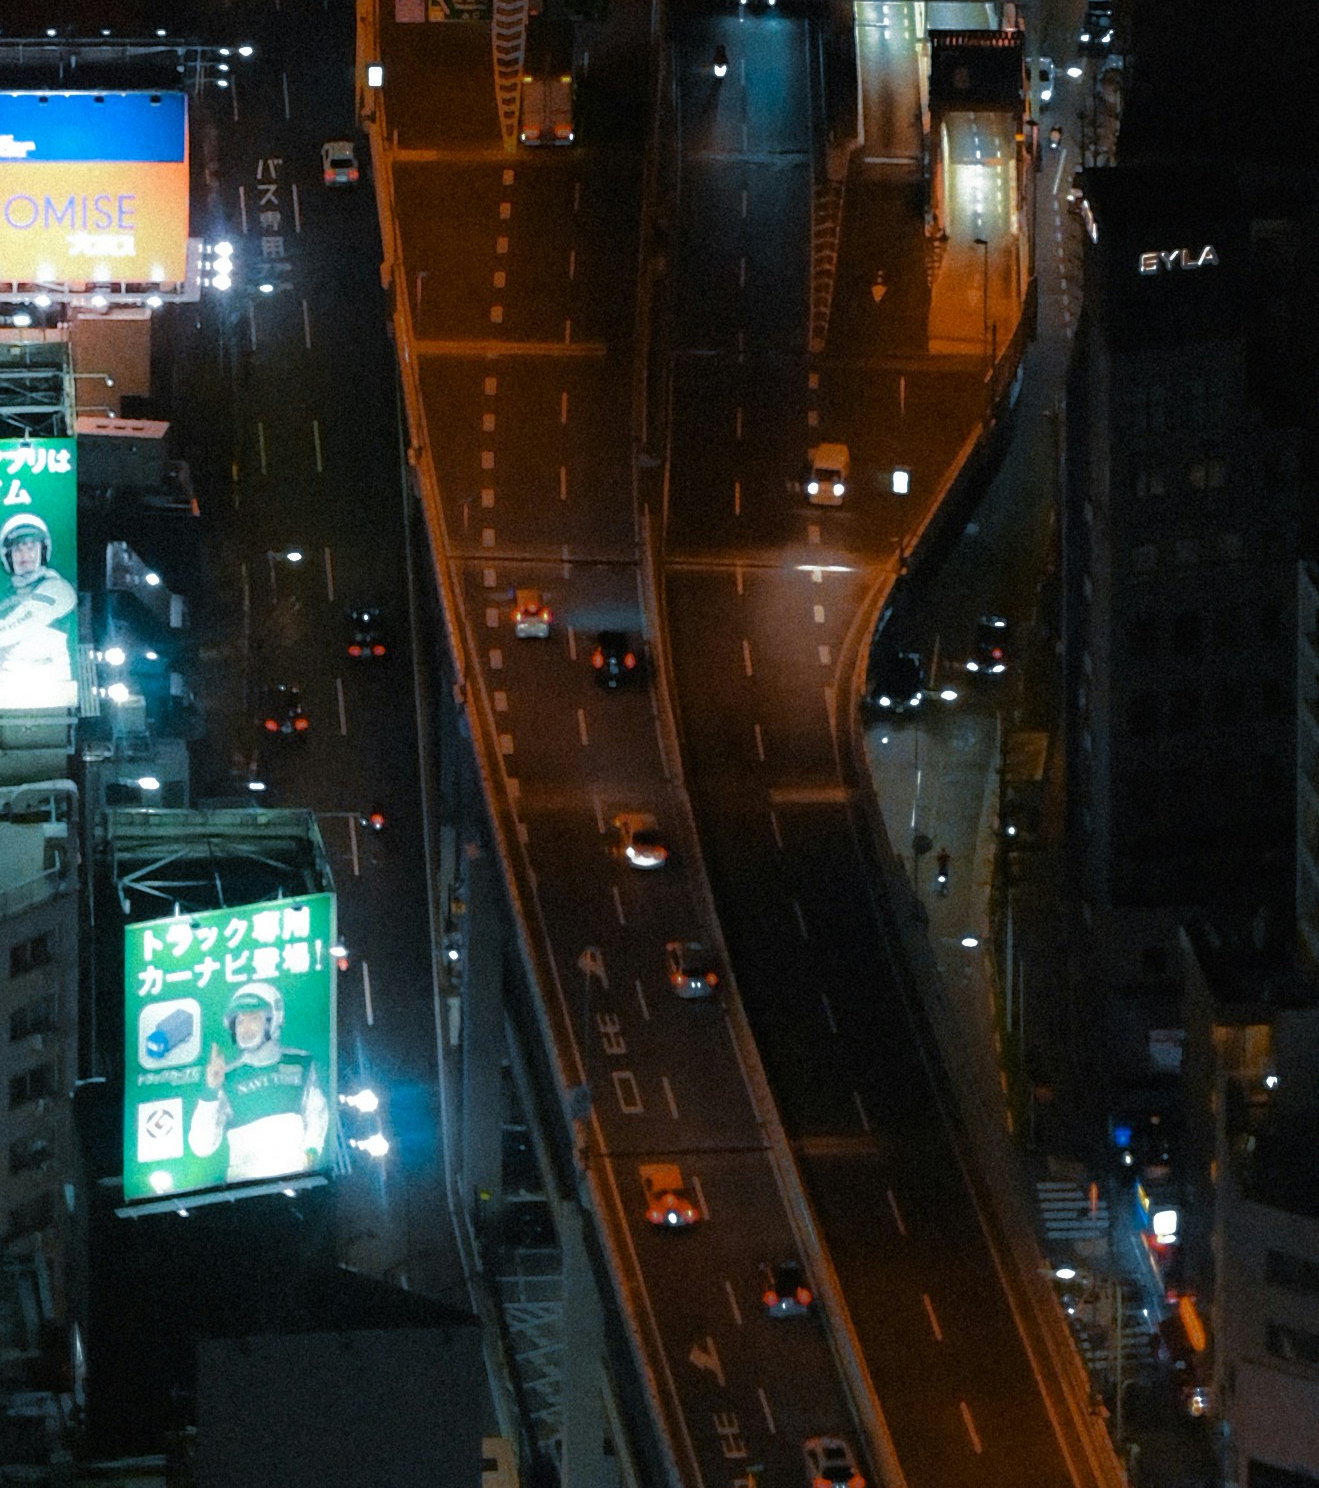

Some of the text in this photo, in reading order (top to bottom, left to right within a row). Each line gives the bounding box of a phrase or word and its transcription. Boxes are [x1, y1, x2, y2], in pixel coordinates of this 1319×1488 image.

[143, 906, 311, 962] トラック専用
